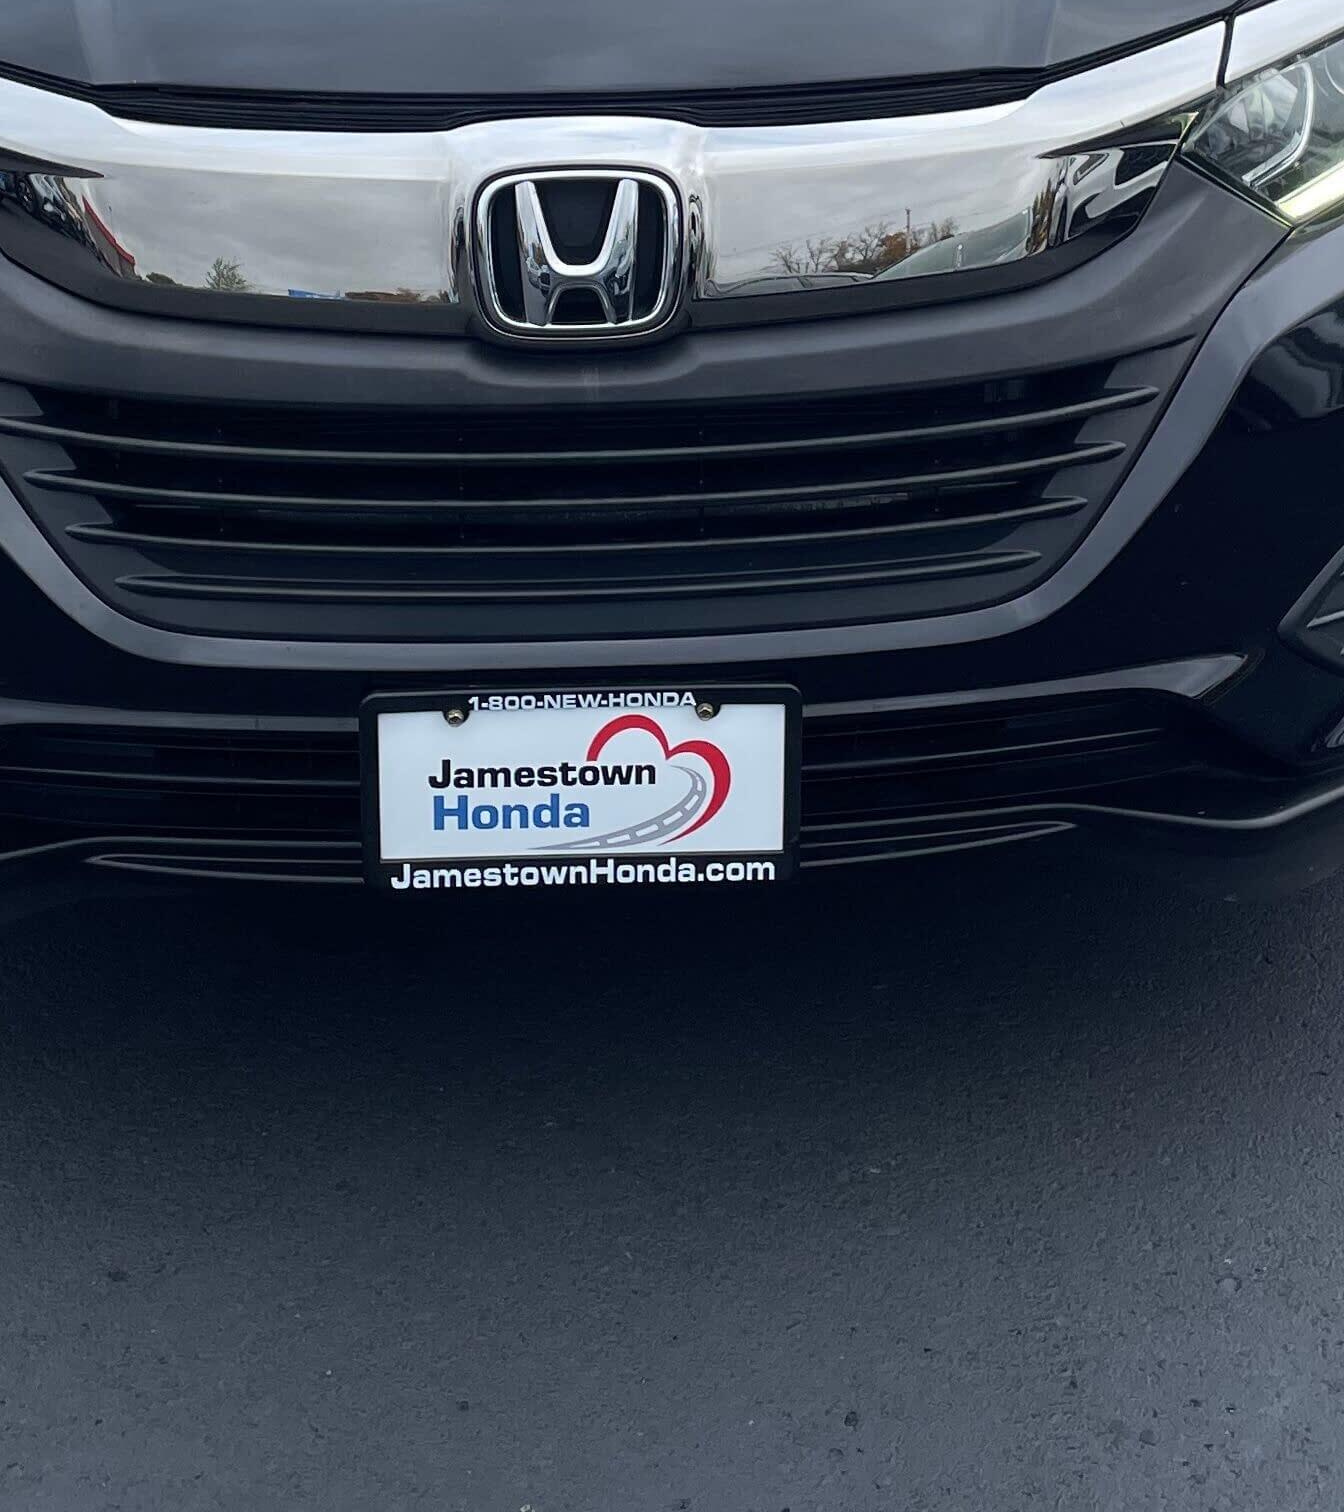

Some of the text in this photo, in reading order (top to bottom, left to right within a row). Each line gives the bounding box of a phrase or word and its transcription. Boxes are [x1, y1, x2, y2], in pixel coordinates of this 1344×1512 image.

[468, 691, 697, 712] 1-800-NEW-HONDA
[428, 759, 657, 789] Jamestown
[432, 794, 591, 831] Honda
[391, 857, 776, 890] JamestownHonda.com
